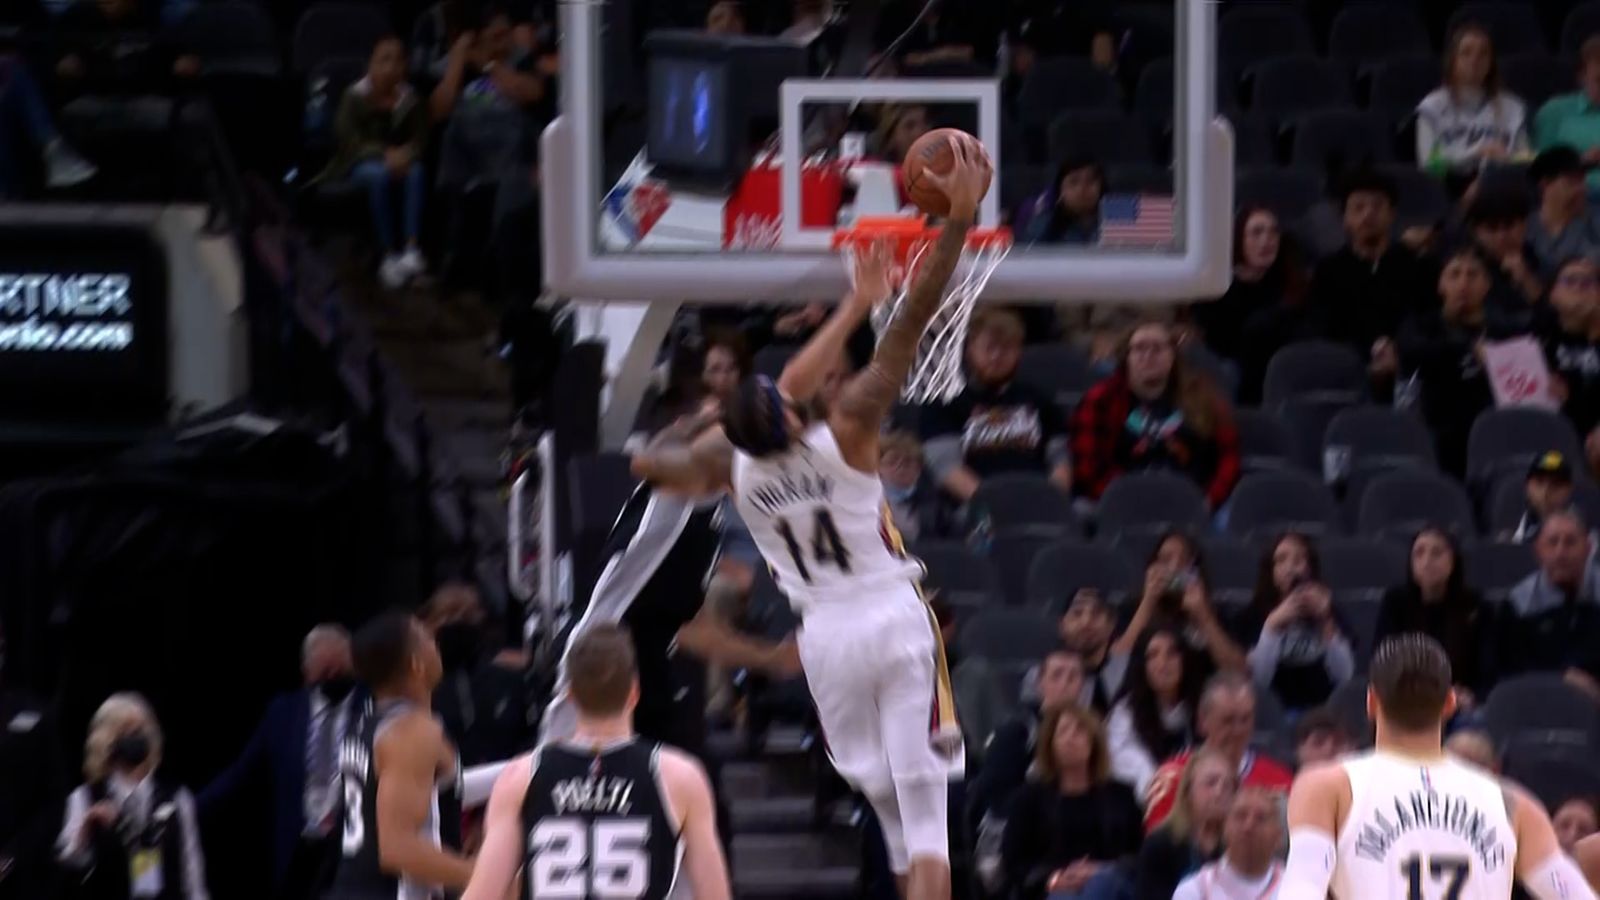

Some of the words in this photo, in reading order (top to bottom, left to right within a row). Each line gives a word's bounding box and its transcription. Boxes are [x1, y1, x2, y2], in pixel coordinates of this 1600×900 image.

[774, 507, 853, 587] 14
[527, 815, 651, 900] 25
[1399, 852, 1471, 900] 17
